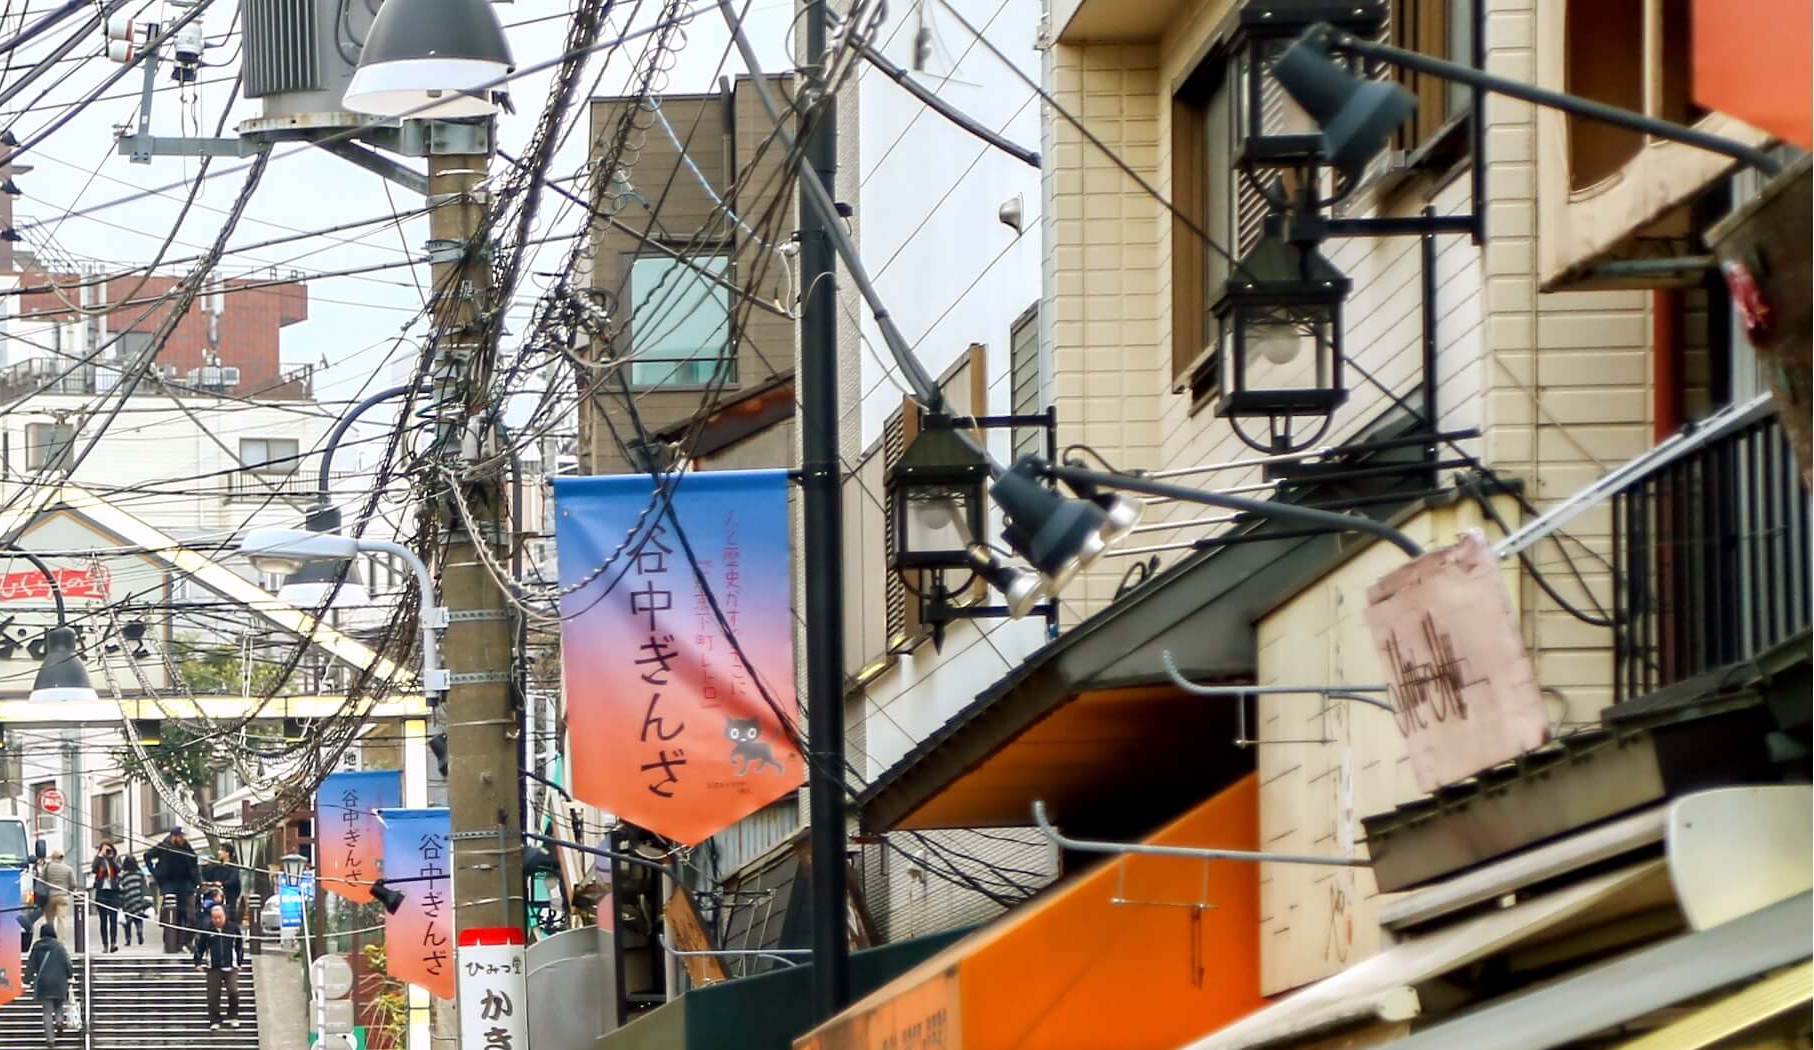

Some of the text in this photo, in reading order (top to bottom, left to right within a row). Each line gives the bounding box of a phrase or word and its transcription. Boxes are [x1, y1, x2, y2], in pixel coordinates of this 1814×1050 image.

[626, 524, 687, 799] 谷中ぎんざ
[341, 789, 362, 888] 谷中ぎんざ
[419, 833, 448, 977] 谷中ぎんざ
